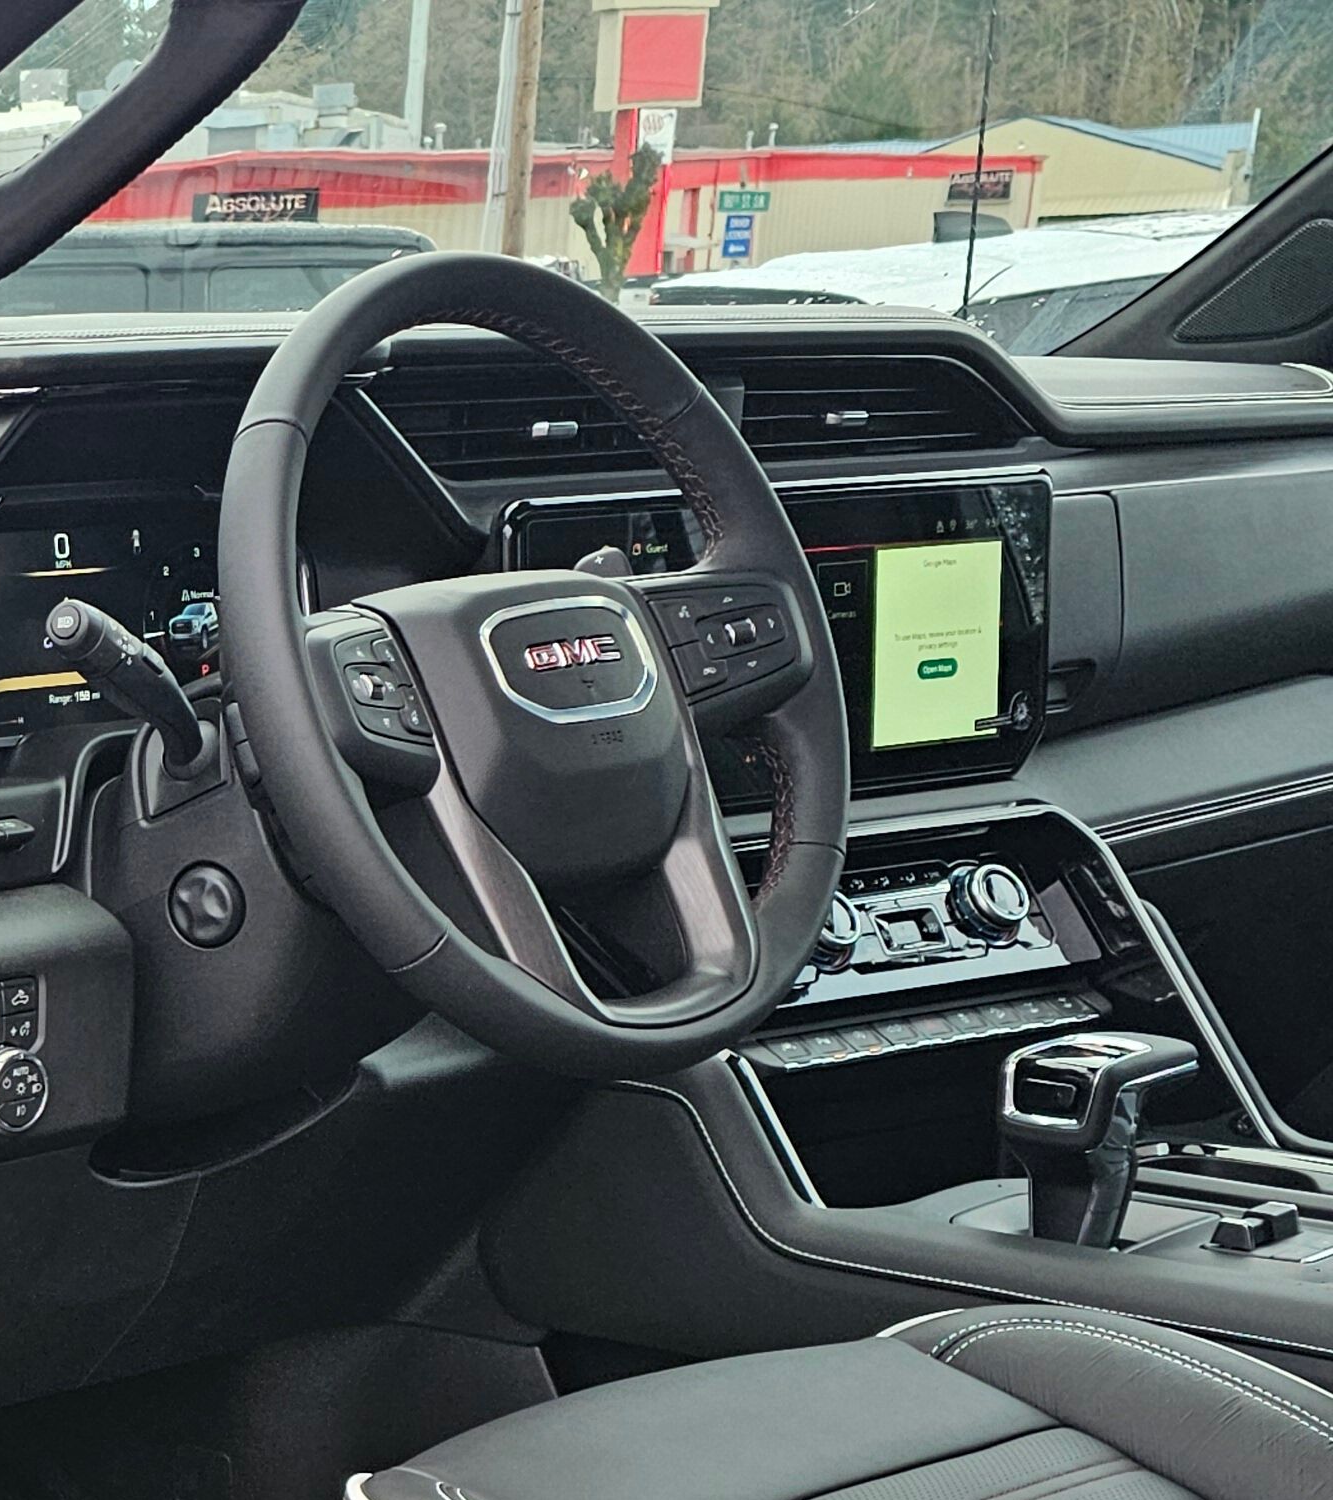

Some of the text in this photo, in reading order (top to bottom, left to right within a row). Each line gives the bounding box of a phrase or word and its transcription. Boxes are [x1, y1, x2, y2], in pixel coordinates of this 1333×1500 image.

[204, 193, 308, 216] ABSOLUTE
[53, 532, 70, 559] 0
[525, 635, 621, 672] GMC
[12, 1066, 30, 1077] AUTO
